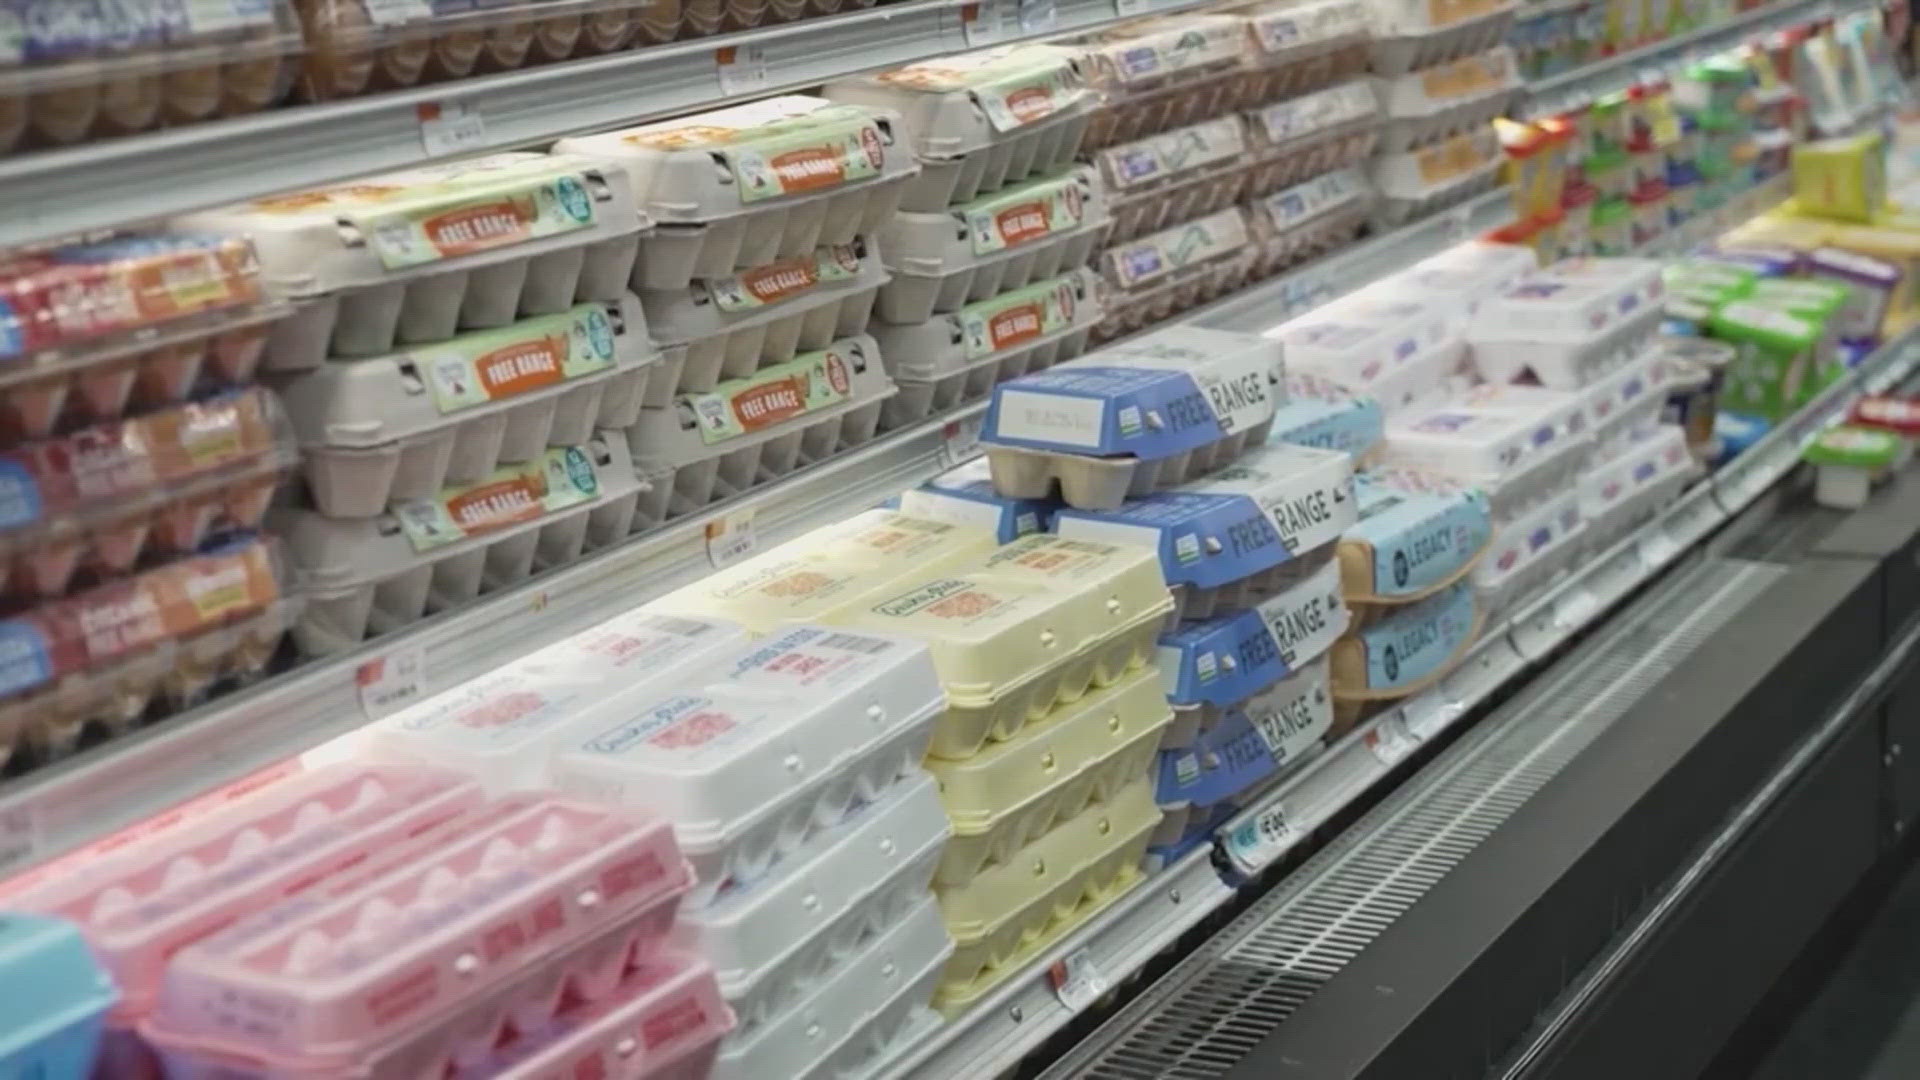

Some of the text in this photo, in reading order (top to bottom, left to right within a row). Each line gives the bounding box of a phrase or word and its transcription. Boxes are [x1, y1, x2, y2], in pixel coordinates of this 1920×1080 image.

[438, 220, 476, 245] FREE
[473, 213, 521, 237] RANGE
[753, 267, 811, 296] FREE RANGE
[487, 361, 519, 386] FREE
[516, 350, 556, 376] RANGE
[740, 389, 799, 420] FREE RANGE
[1167, 391, 1211, 434] FREE
[1210, 372, 1265, 415] RANGE
[460, 500, 492, 524] FREE
[490, 488, 532, 513] RANGE
[1227, 489, 1331, 558] FREE RANGE
[1409, 524, 1451, 568] LEGACY
[1239, 597, 1326, 677] FREE RANGE
[1398, 617, 1440, 662] LEGACY
[1223, 694, 1313, 774] FREE RANGE
